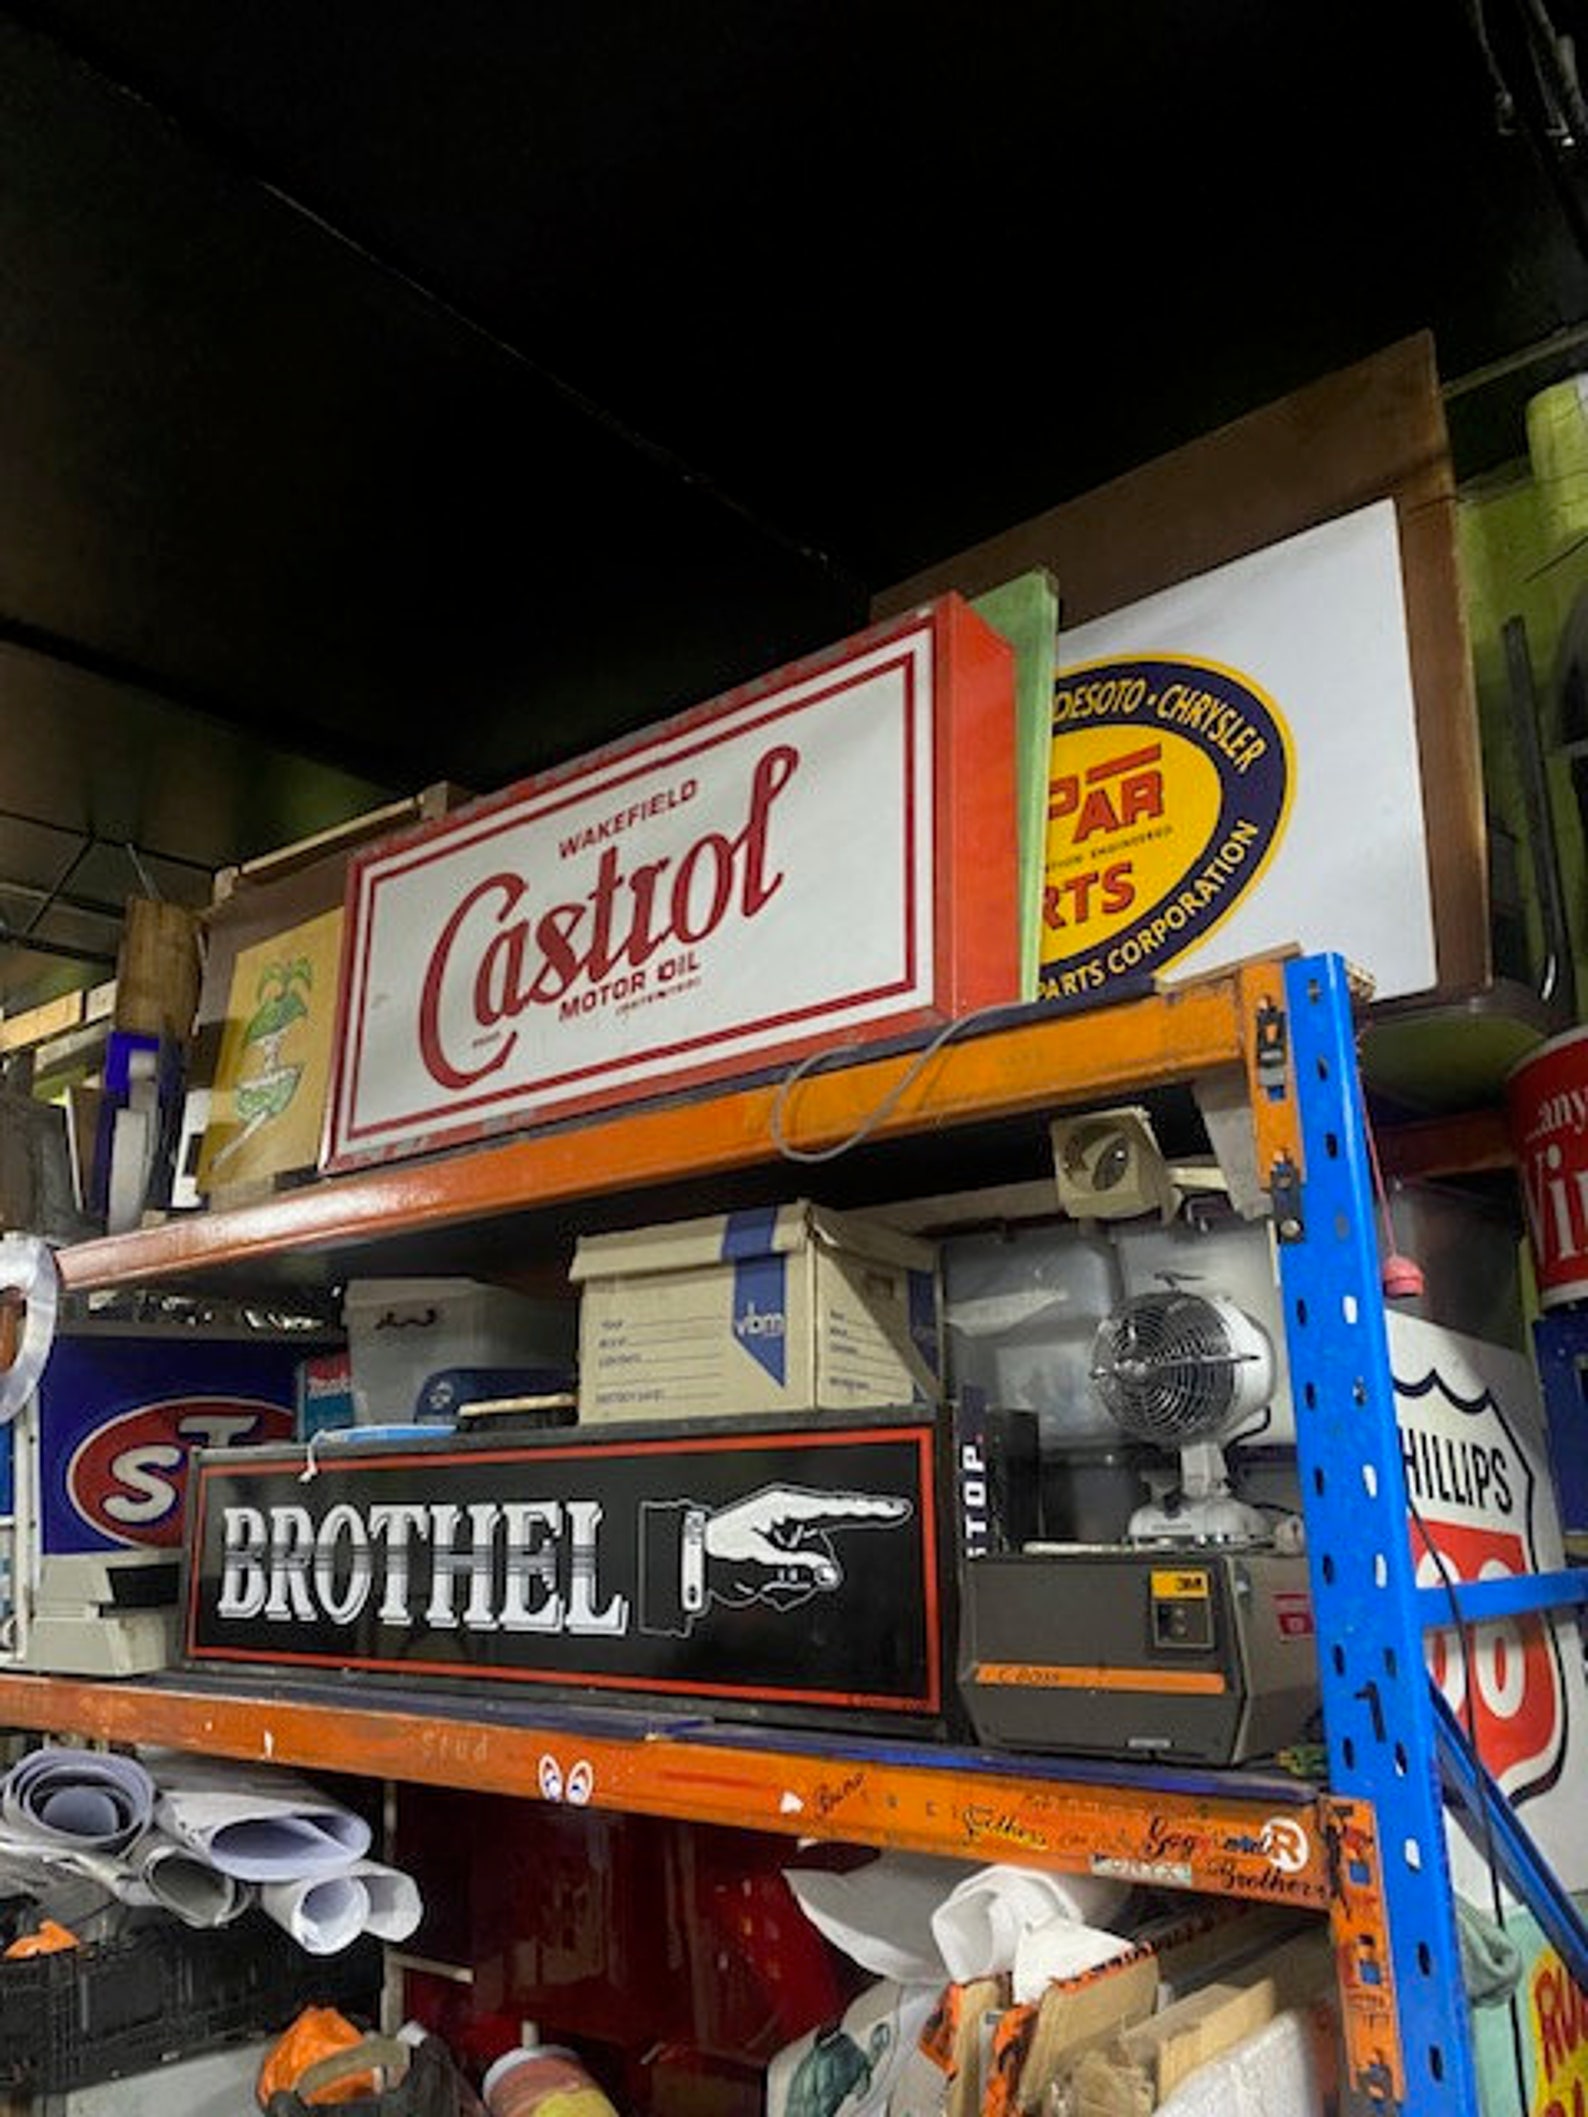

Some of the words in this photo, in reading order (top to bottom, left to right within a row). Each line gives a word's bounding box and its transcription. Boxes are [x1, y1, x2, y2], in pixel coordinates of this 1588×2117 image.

[1053, 679, 1146, 723] DESOTO
[1156, 683, 1268, 774] CHRYSLER
[558, 779, 697, 860] WAKEFIELD
[1046, 768, 1164, 844] PAR
[418, 744, 800, 1090] Castrol
[1043, 861, 1135, 931] RTS
[1107, 818, 1259, 974] CORPORATION
[558, 971, 646, 1022] MOTOR
[657, 952, 700, 982] OIL
[736, 1302, 784, 1337] vbm
[103, 1414, 259, 1525] ST
[1396, 1427, 1513, 1515] HILLIPS
[217, 1502, 630, 1636] BROTHEL
